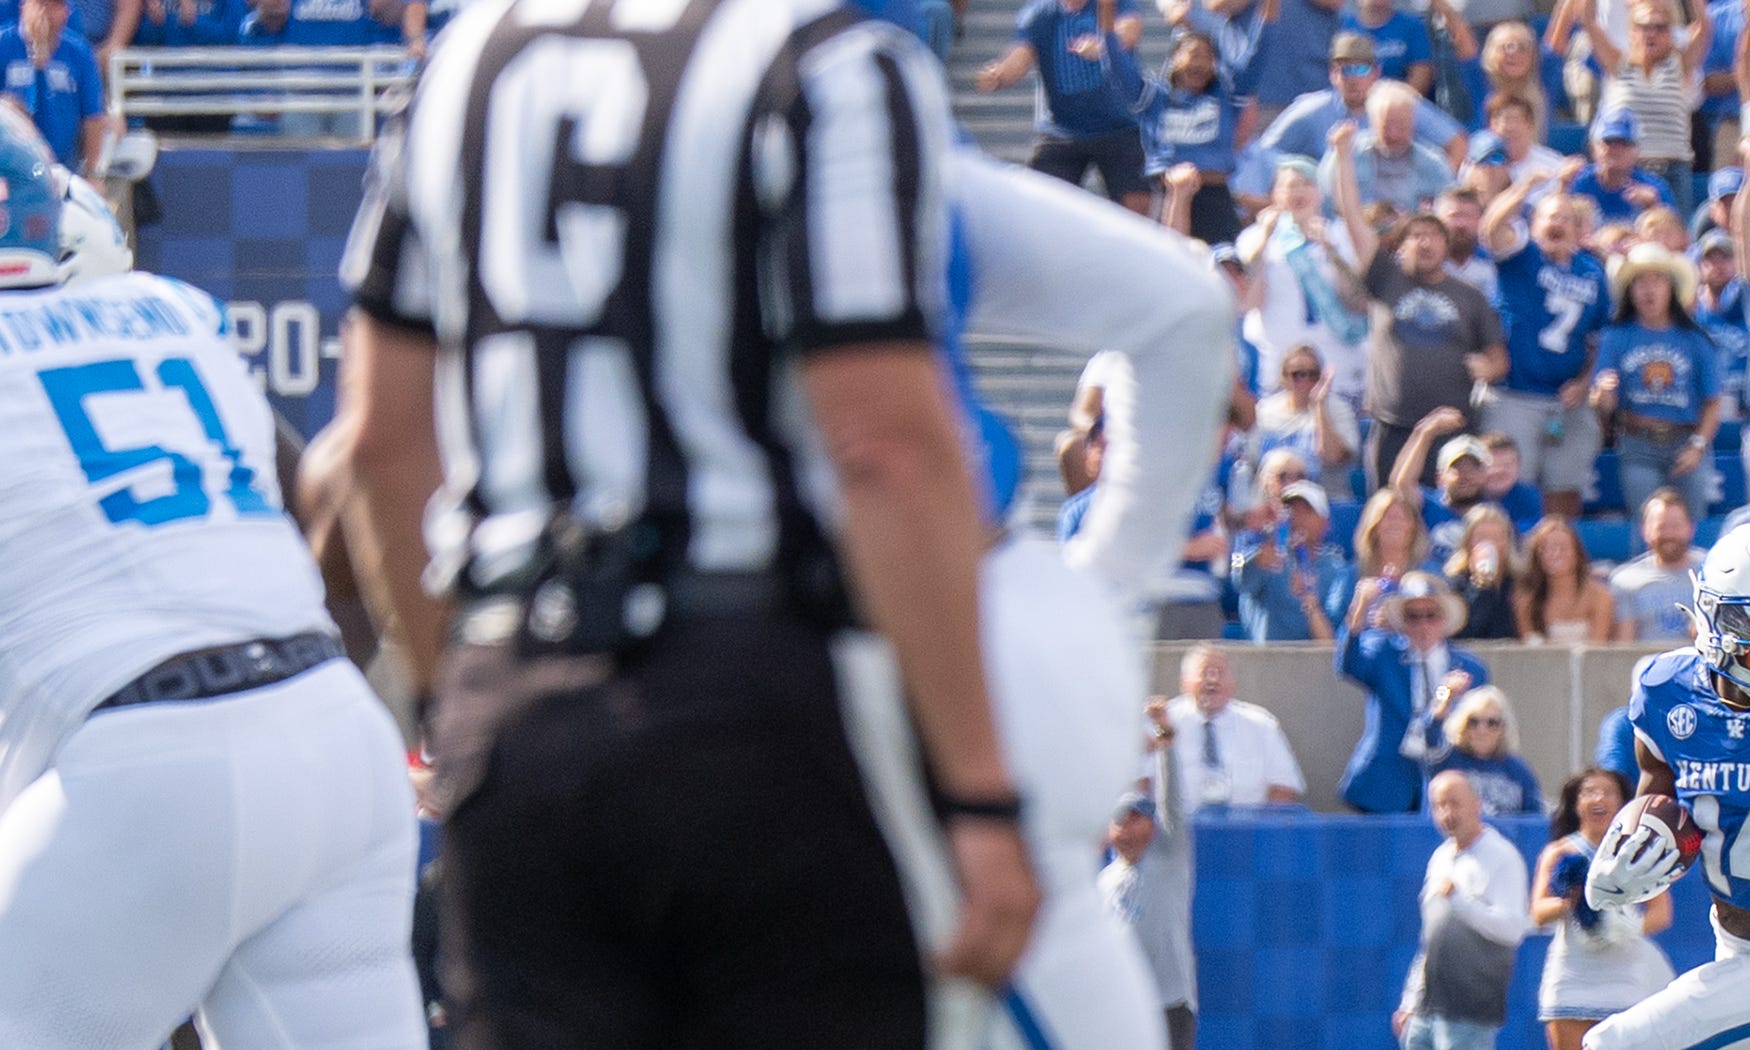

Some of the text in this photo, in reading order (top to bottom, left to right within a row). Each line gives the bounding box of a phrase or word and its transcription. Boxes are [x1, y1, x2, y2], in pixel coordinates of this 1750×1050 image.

[478, 32, 649, 328] C
[37, 358, 286, 525] 51
[1669, 708, 1696, 735] SEC
